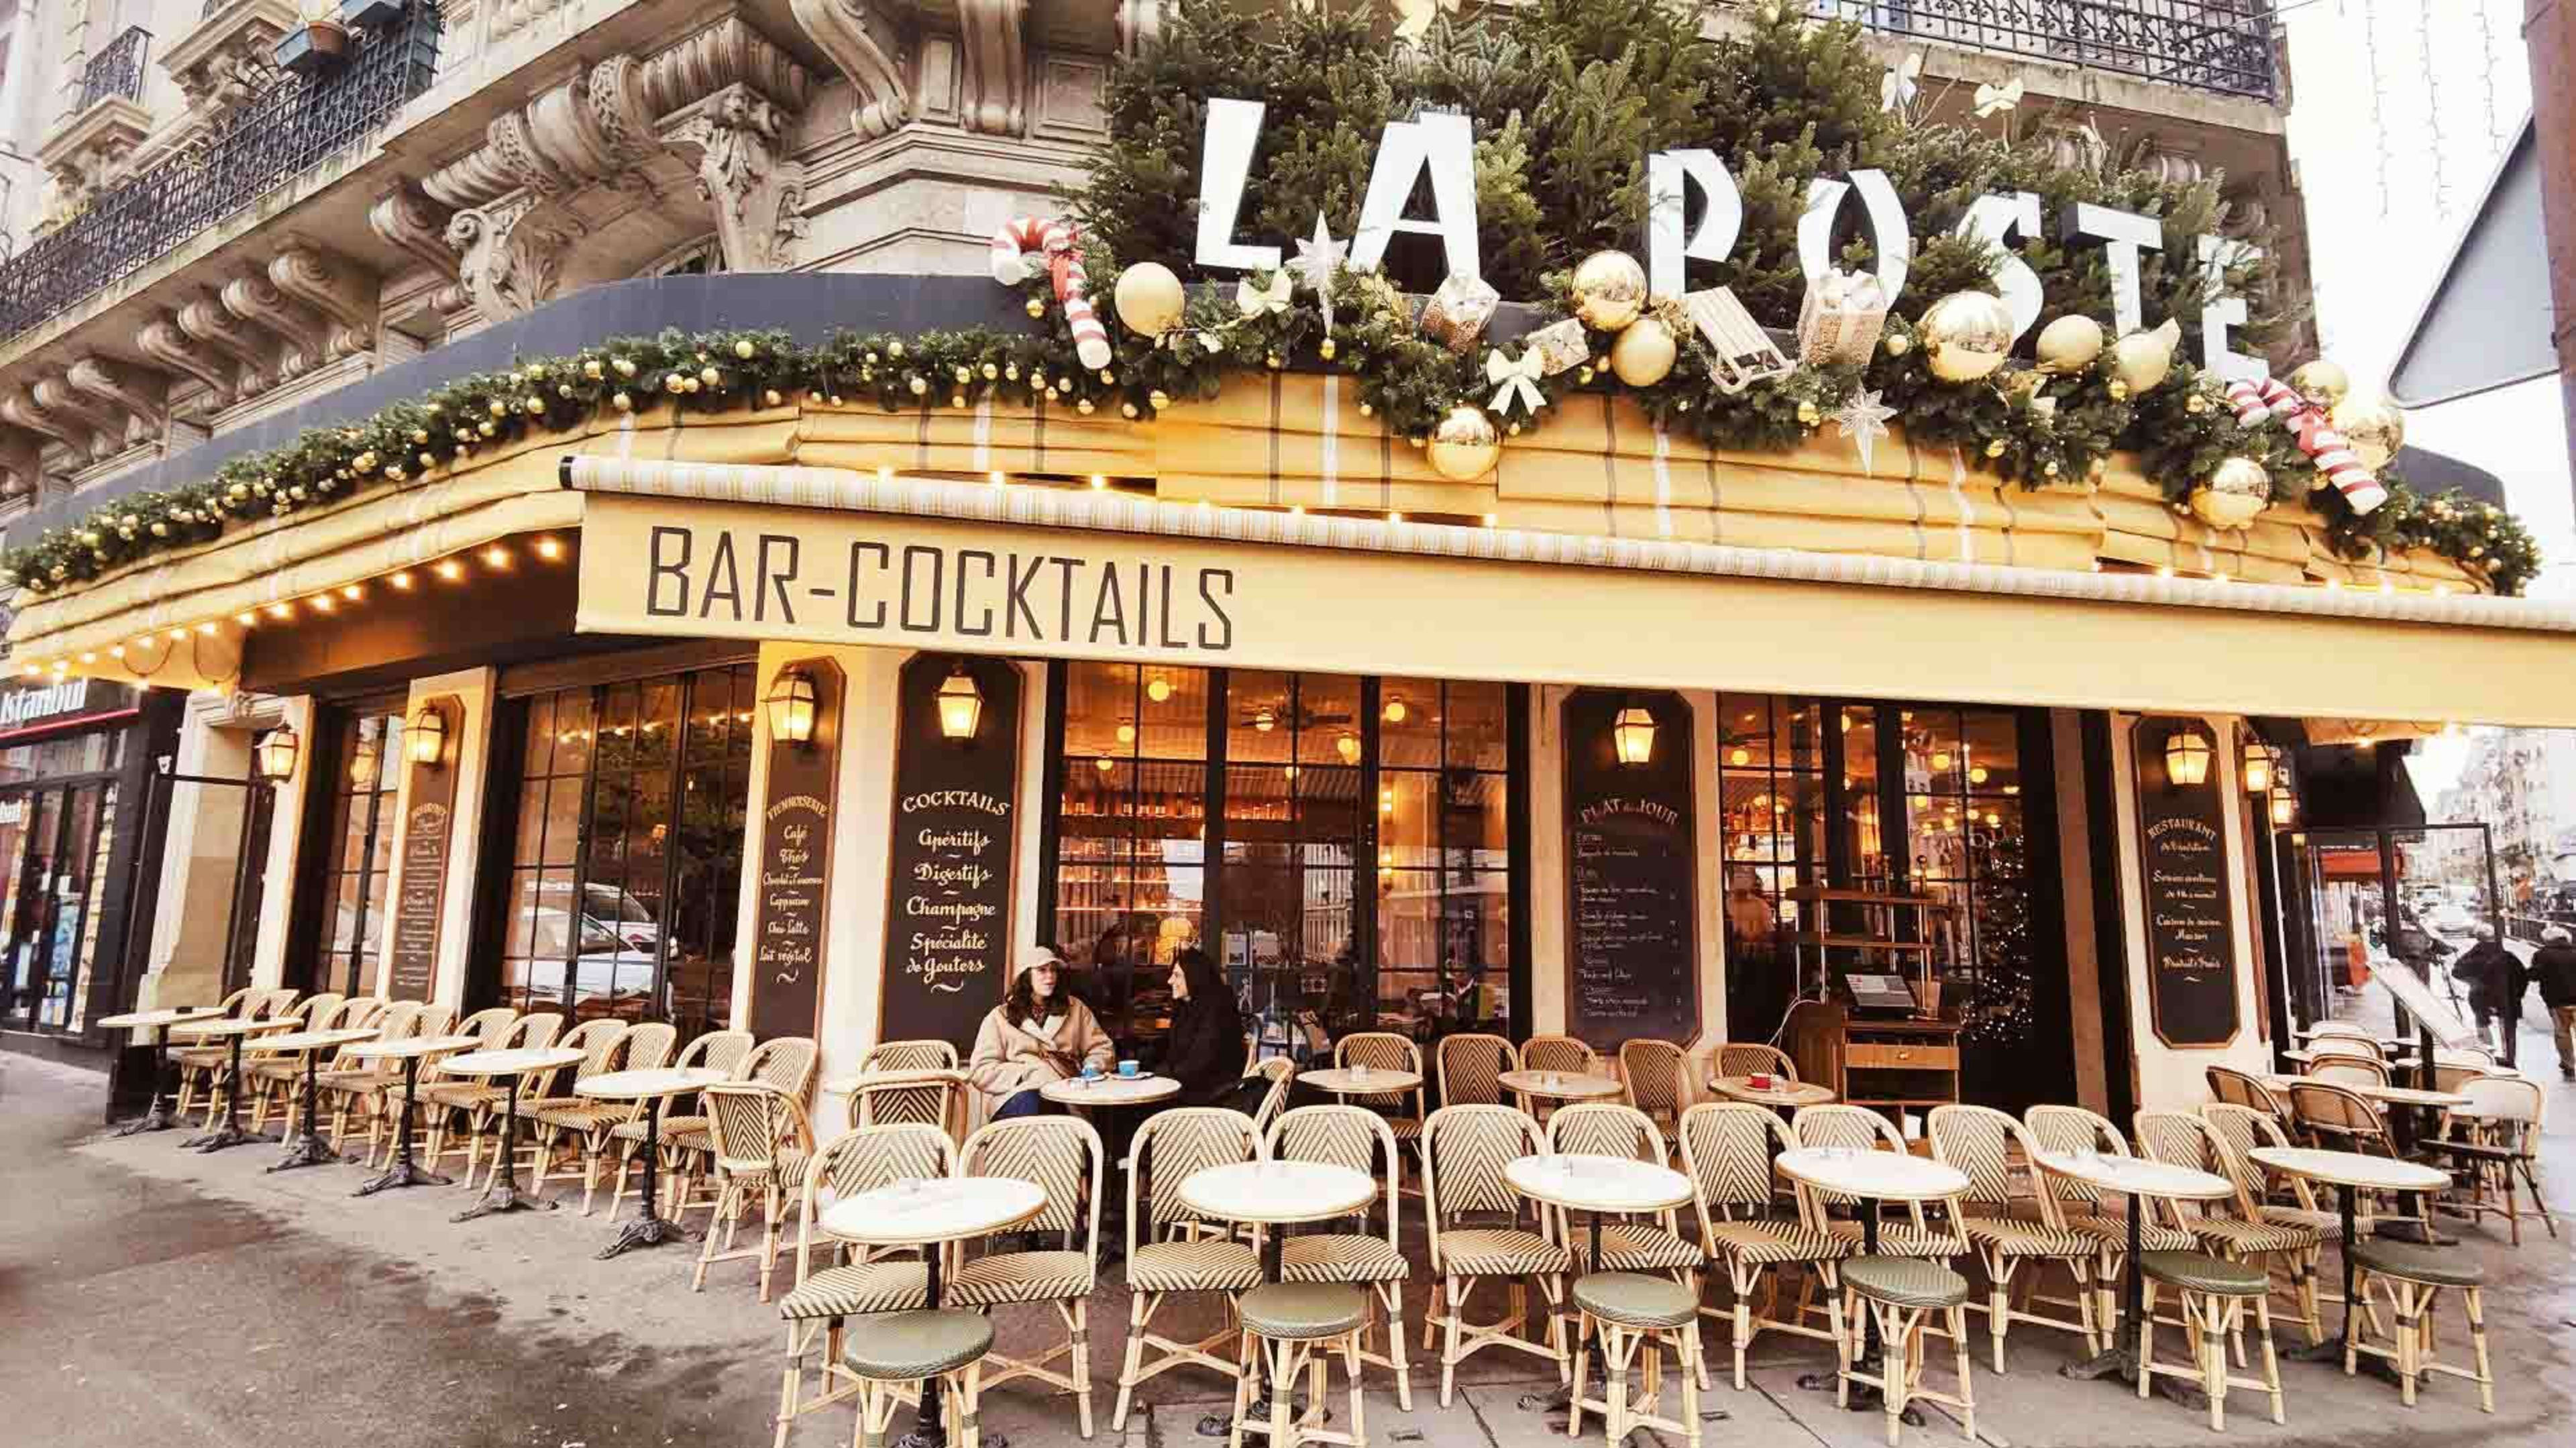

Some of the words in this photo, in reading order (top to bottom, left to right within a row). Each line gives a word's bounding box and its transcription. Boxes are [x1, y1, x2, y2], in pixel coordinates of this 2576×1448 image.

[1196, 98, 1480, 282] LA
[1650, 148, 2271, 385] POSTE
[646, 525, 1234, 651] BAR-COCKTAILS
[903, 790, 1011, 816] COCKTAILS
[1582, 798, 1621, 824] PLAT
[784, 824, 808, 847] Café
[918, 828, 992, 855] Apéritifs
[2147, 818, 2216, 841] RESTAURANT
[913, 862, 993, 889] Digestifs
[906, 895, 996, 924] Champagne
[906, 957, 922, 973] de
